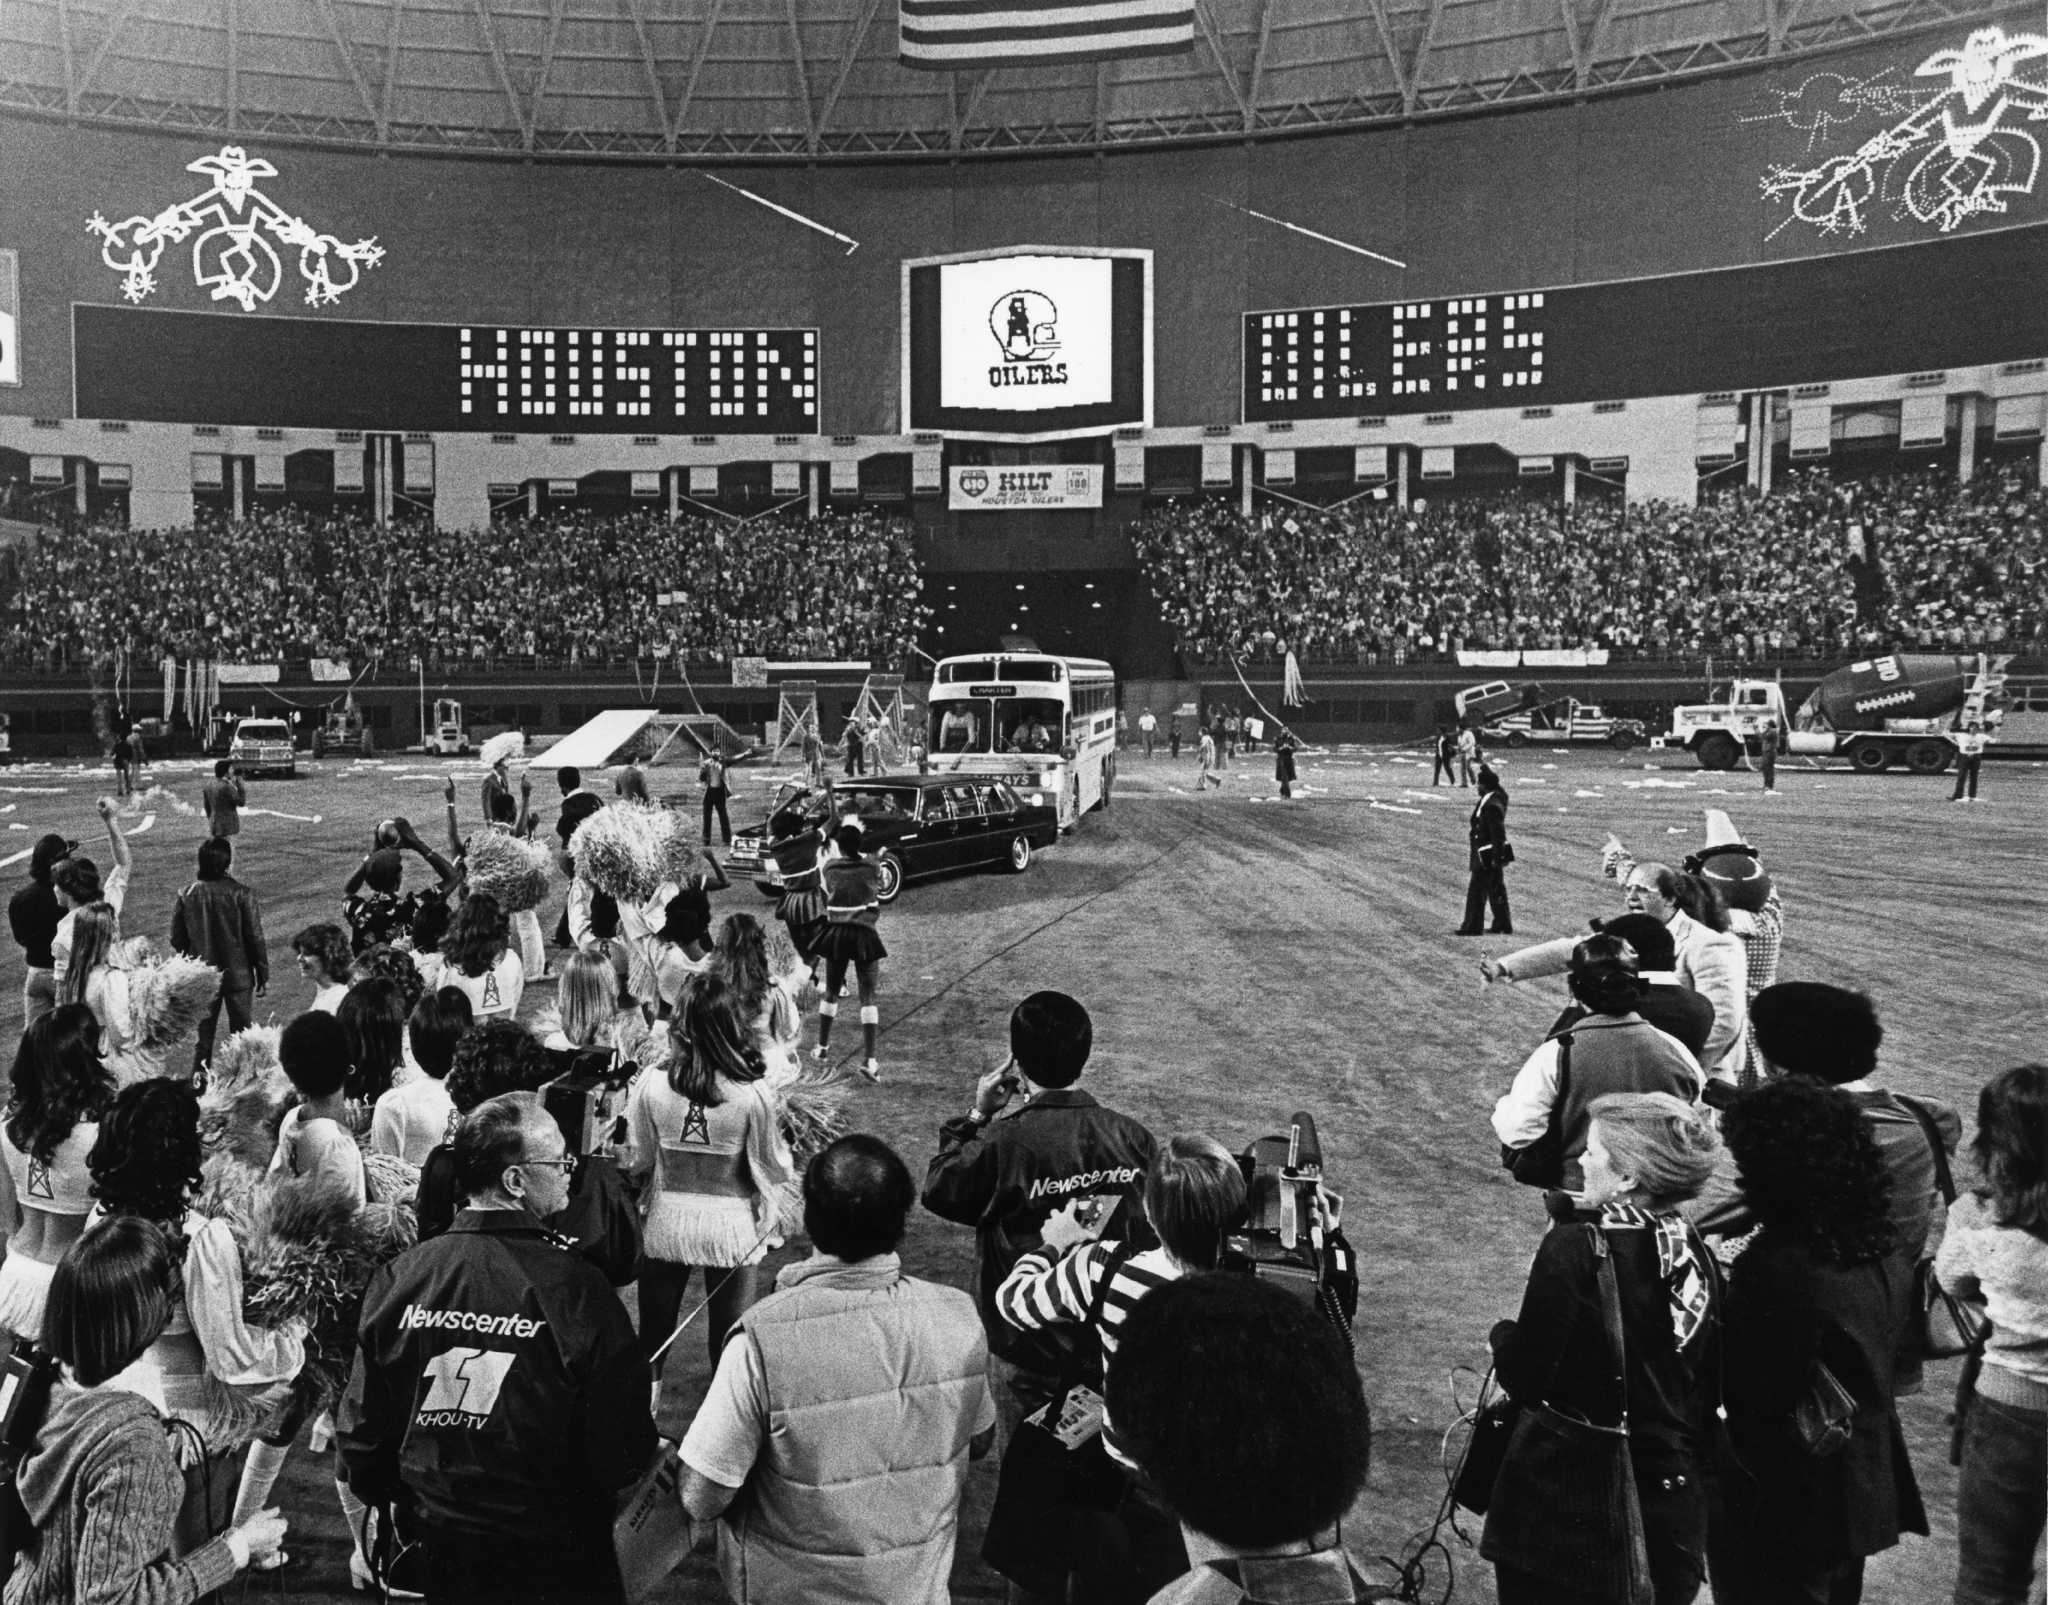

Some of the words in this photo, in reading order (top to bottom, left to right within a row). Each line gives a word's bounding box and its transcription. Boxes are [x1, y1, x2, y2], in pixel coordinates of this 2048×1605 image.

[1262, 293, 1544, 402] OILERS
[461, 329, 814, 415] HOUSTON
[988, 363, 1068, 387] OILERS
[998, 472, 1052, 491] KILT
[1029, 1167, 1140, 1200] Newscenter
[398, 1303, 546, 1338] Newscenter
[415, 1412, 488, 1430] KHOU-TV
